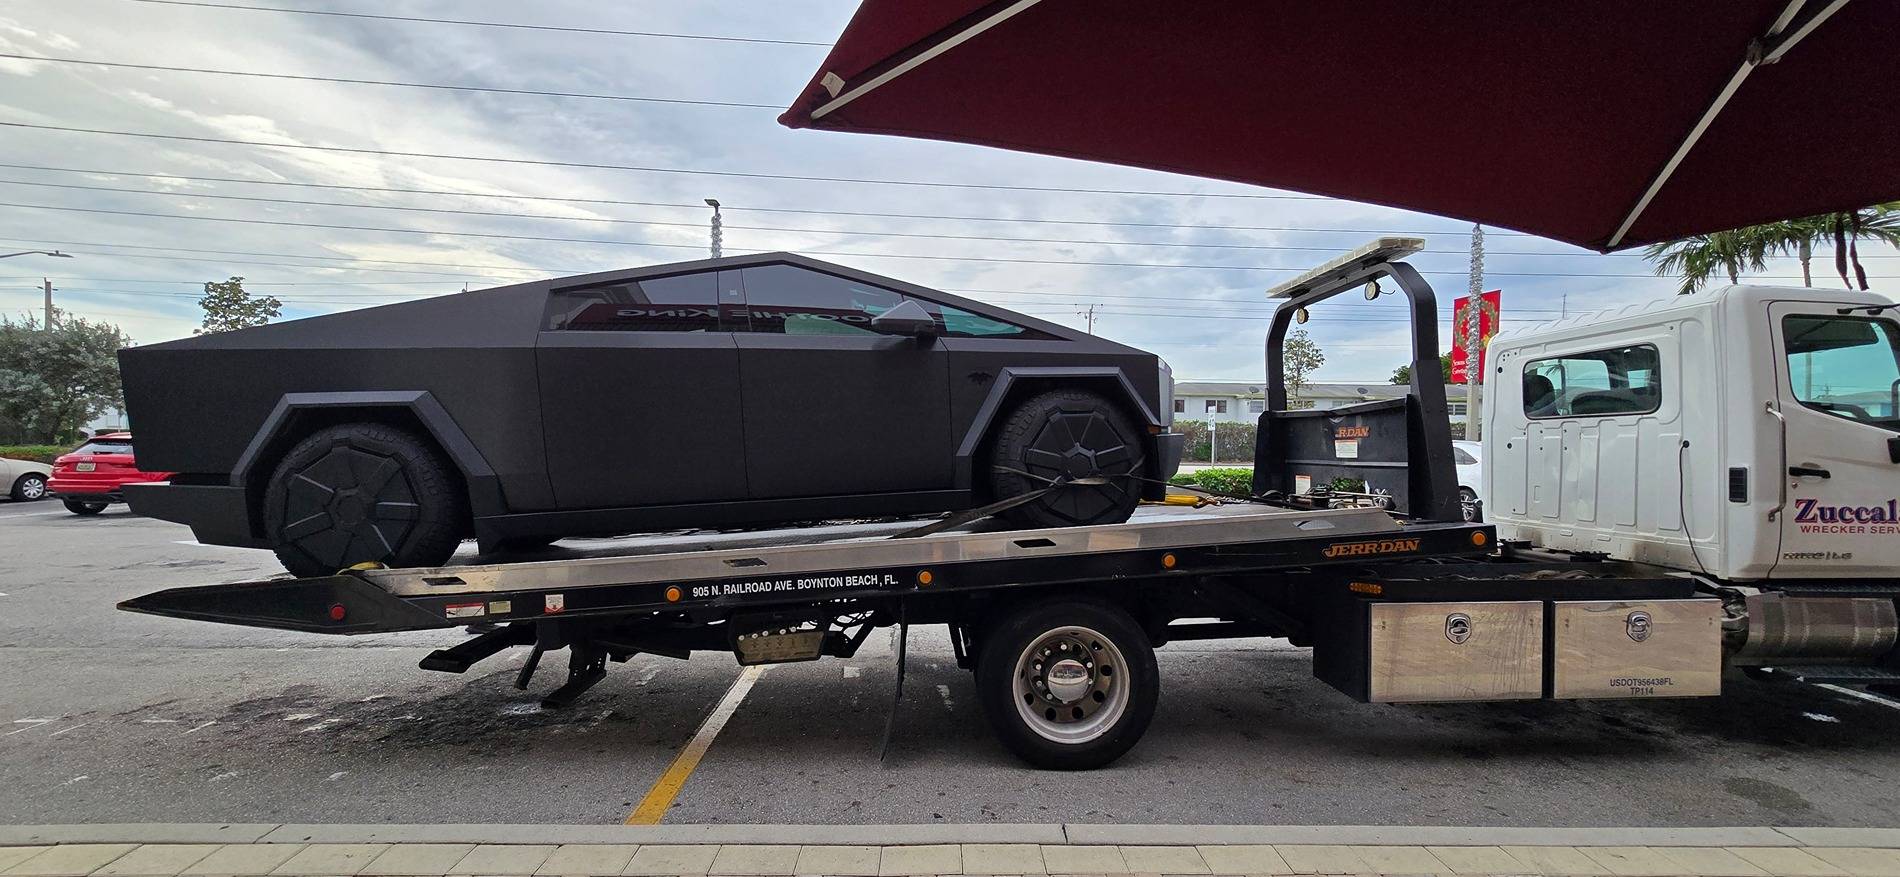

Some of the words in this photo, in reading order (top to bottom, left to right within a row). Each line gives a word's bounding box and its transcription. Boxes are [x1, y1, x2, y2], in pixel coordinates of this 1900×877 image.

[1794, 498, 1900, 524] Zuccal
[1800, 525, 1866, 534] WRECKER
[692, 586, 710, 598] 905
[711, 585, 722, 596] N.
[723, 581, 772, 595] RAILROAD
[774, 580, 795, 592] AVE.
[797, 576, 844, 590] BOYNTON
[884, 574, 899, 586] FL.
[1630, 687, 1654, 696] TP114
